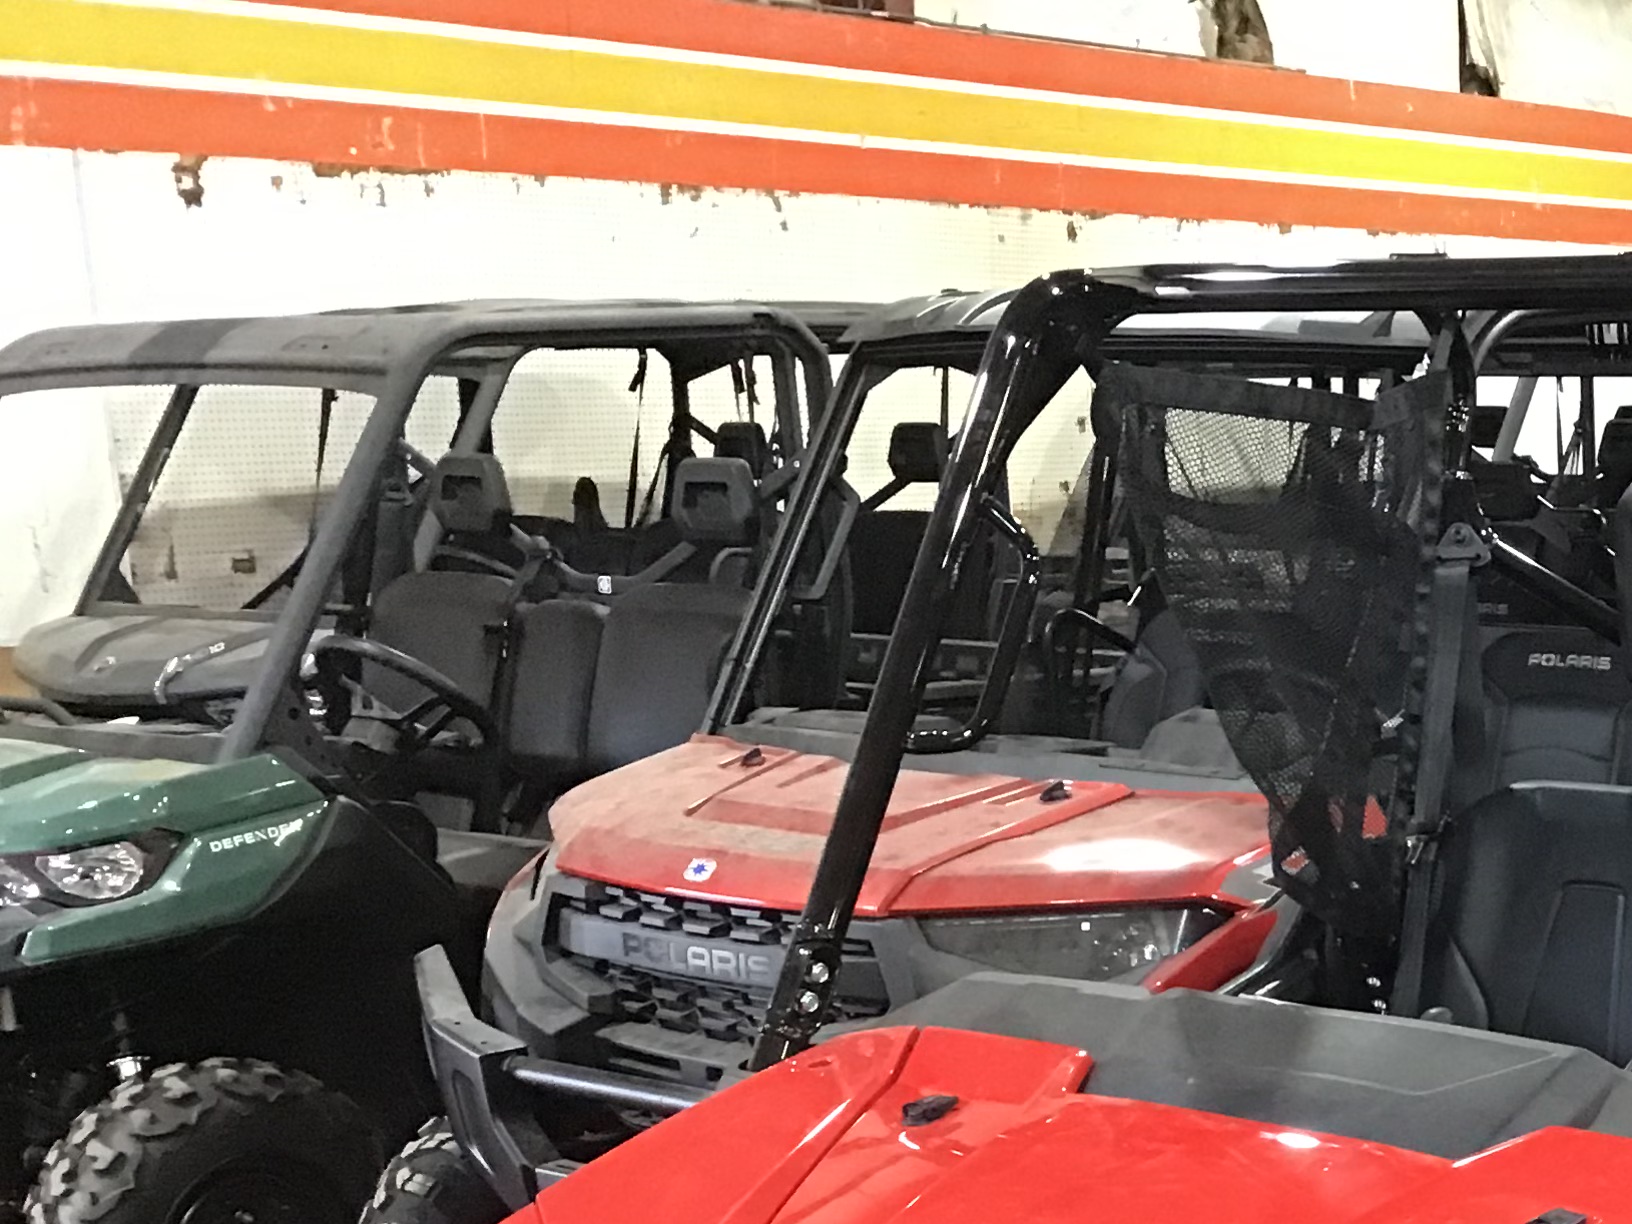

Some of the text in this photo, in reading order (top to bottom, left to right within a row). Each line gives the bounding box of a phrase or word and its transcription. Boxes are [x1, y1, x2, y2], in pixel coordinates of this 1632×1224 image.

[1527, 653, 1612, 670] POLARIS
[209, 818, 303, 852] DEFENDE
[622, 932, 770, 982] POLARIS
